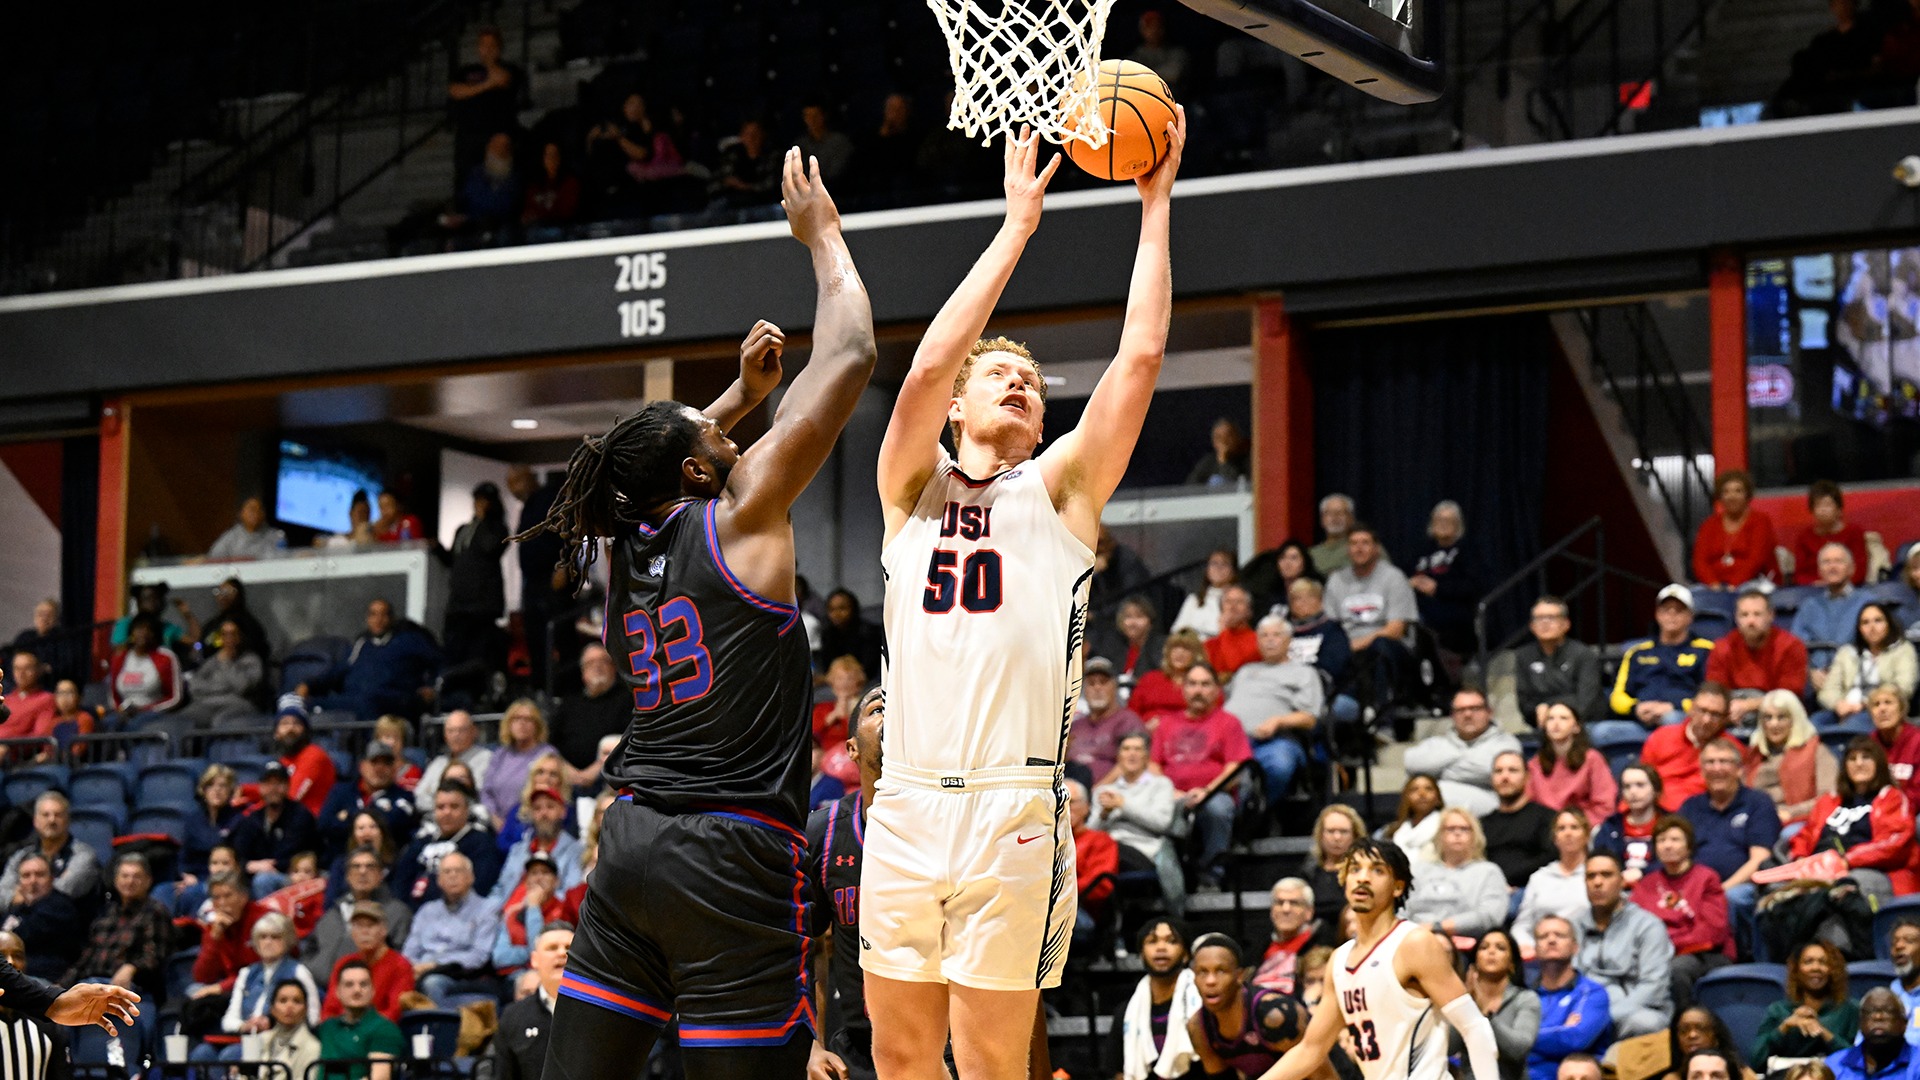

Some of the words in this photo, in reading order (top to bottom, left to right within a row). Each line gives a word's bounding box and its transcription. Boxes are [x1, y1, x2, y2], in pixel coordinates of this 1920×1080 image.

[615, 252, 667, 292] 205
[617, 298, 665, 337] 105
[940, 501, 992, 541] USI
[923, 547, 1003, 614] 50
[623, 596, 714, 711] 33
[941, 777, 964, 787] USI
[1344, 987, 1368, 1014] USI
[1347, 1020, 1381, 1062] 33
